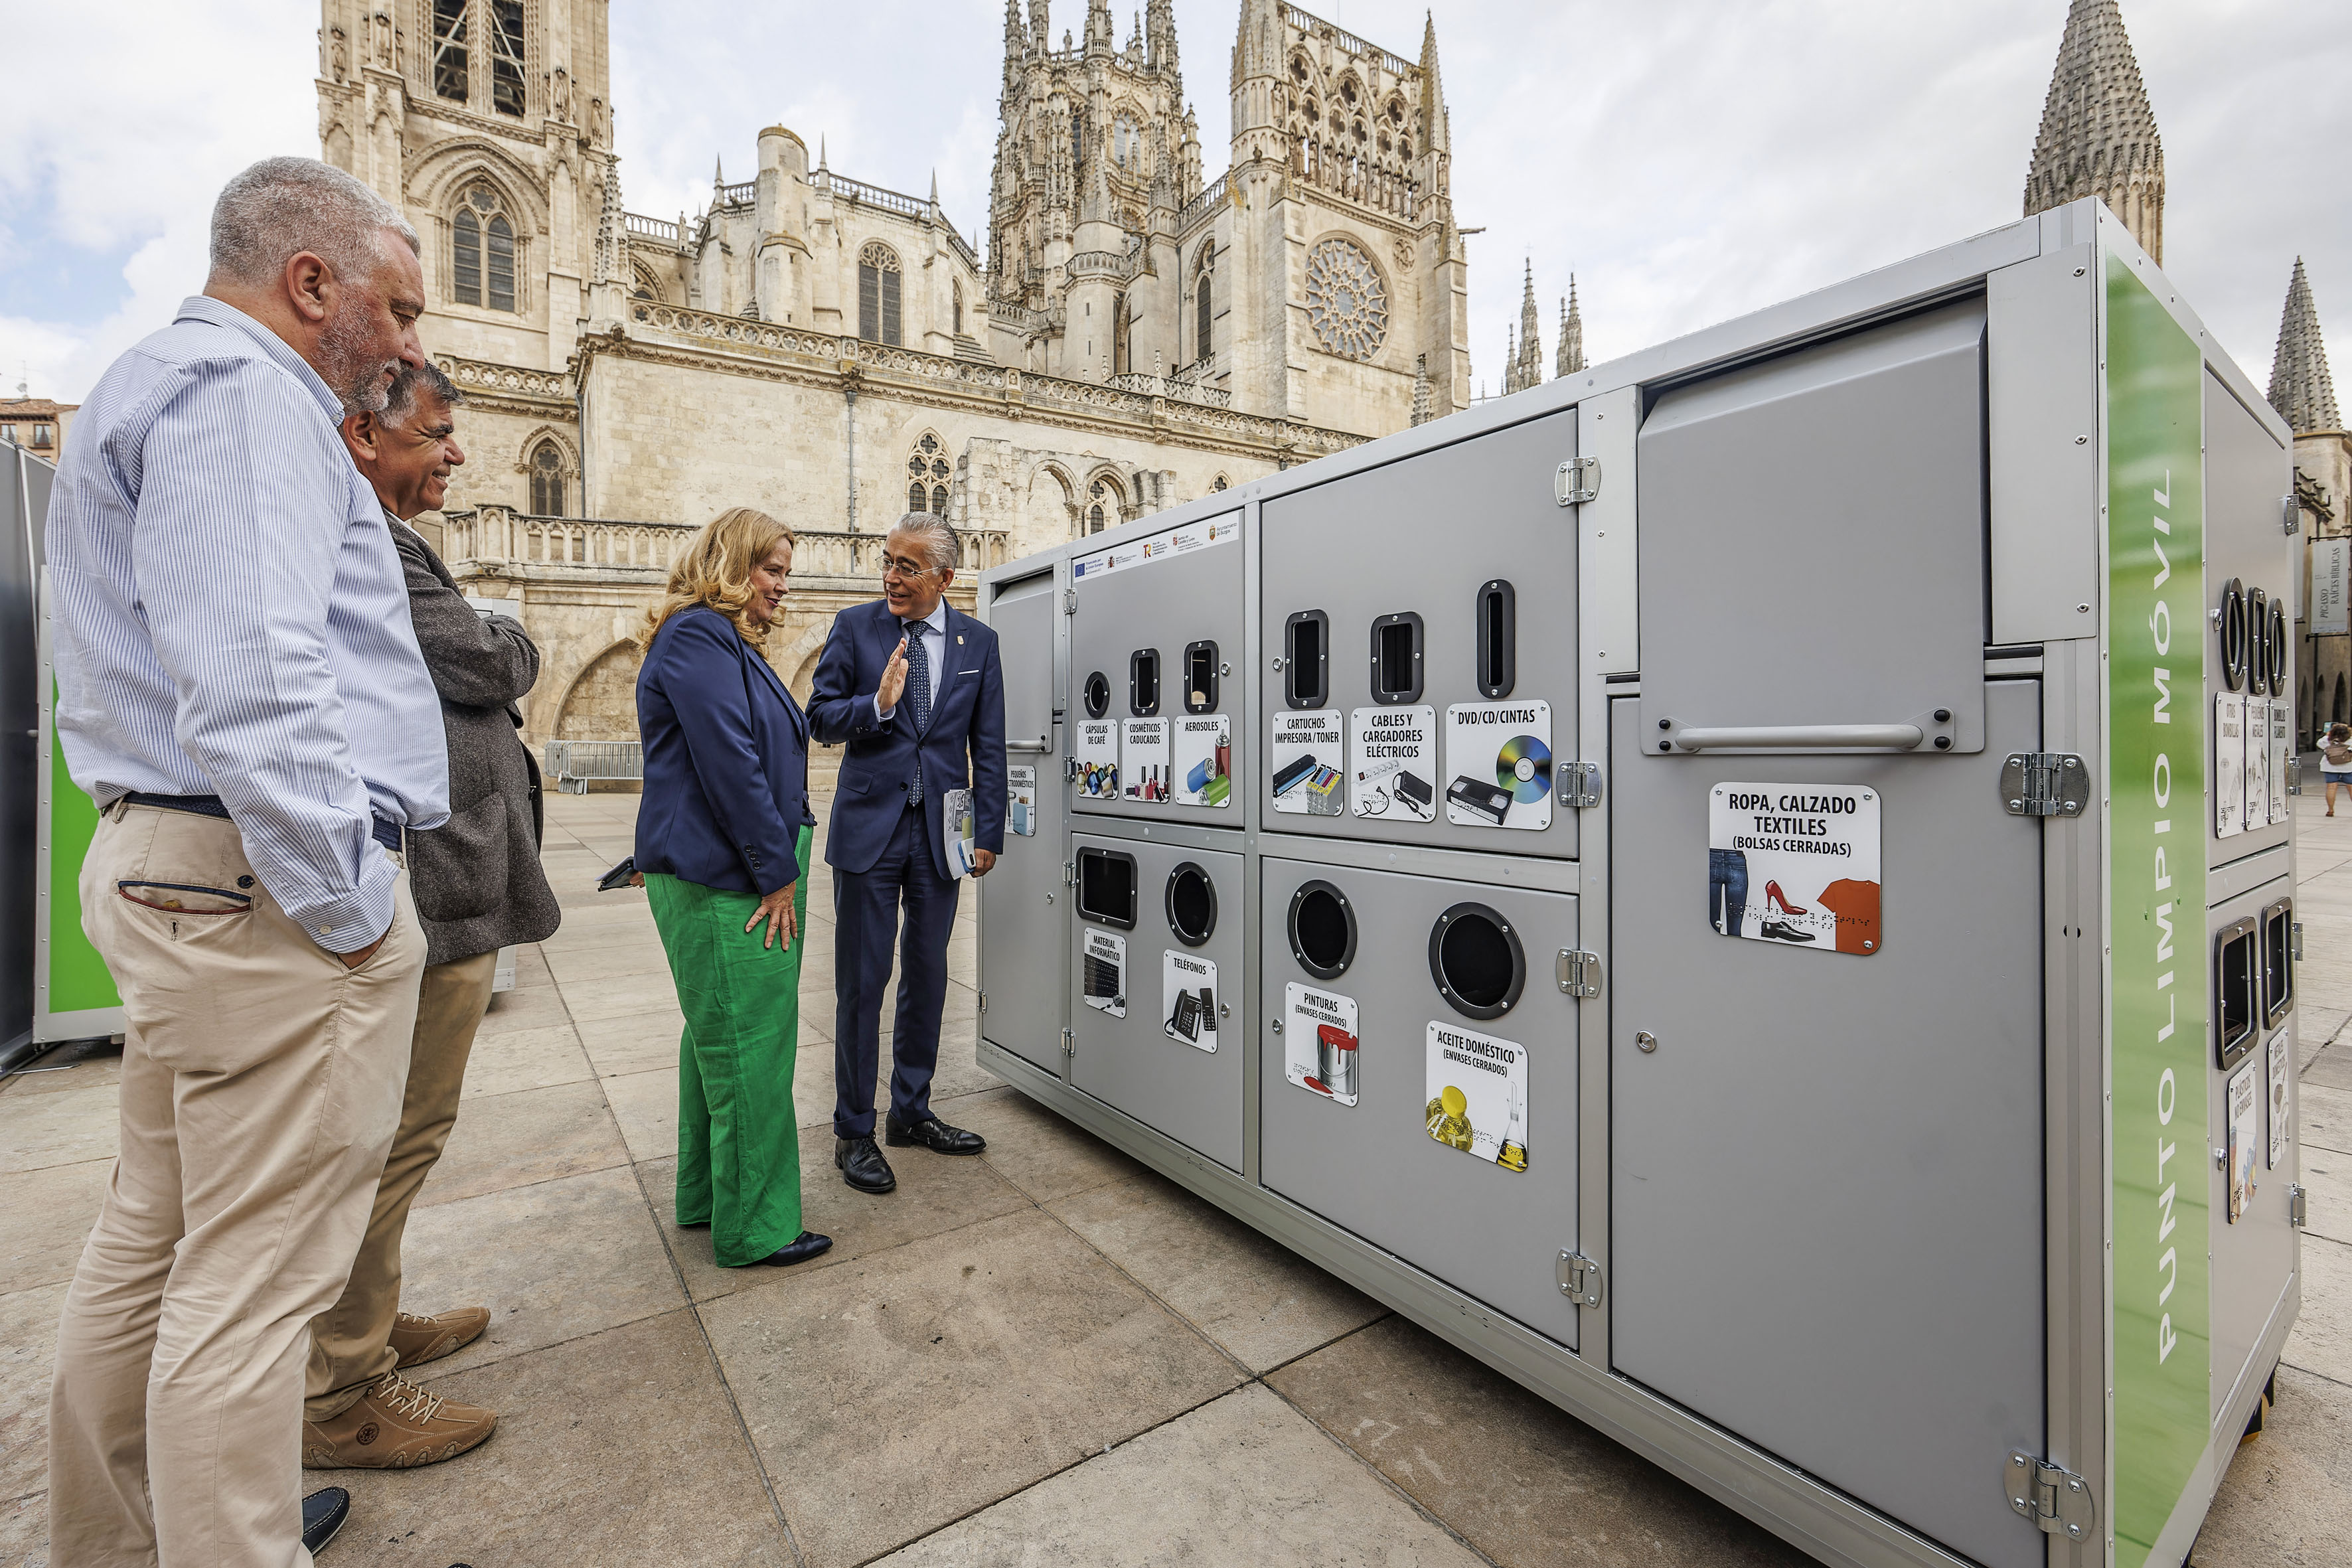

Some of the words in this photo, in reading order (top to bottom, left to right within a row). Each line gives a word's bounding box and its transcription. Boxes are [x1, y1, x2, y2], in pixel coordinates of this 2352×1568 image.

[2329, 547, 2341, 579] BÍBLICAS
[2149, 469, 2170, 723] MÓVIL
[2329, 580, 2339, 605] RAÍCES
[2320, 589, 2329, 619] PICASSO
[1185, 721, 1219, 732] AEROSOLES
[1287, 717, 1326, 730] CARTUCHOS
[1372, 714, 1403, 728] CABLES
[1403, 714, 1413, 726] Y
[1458, 709, 1535, 726] DVD/CD/CINTAS
[1085, 724, 1108, 734] CÁPSULAS
[1129, 722, 1161, 733] COSMÉTICOS
[1363, 730, 1423, 742] CARGADORES
[1094, 734, 1105, 744] CAFÉ
[1130, 735, 1160, 744] CADUCADOS
[1366, 743, 1419, 758] ELÉCTRICOS
[1011, 769, 1026, 779] PEQUEÑOS
[1729, 793, 1776, 813] ROPA,
[1779, 795, 1856, 815] CALZADO
[1754, 816, 1827, 836] TEXTILES
[1733, 835, 1780, 851] (BOLSAS
[1783, 839, 1851, 858] CERRADAS)
[2154, 753, 2174, 1043] LIMPIO
[1093, 935, 1116, 949] MATERIAL
[1089, 944, 1120, 961] INFORMÁTICO
[1173, 957, 1206, 975] TELÉFONOS
[1304, 992, 1338, 1013] PINTURAS
[1295, 1003, 1318, 1019] (ENVASES
[1318, 1010, 1347, 1029] CERRADOS)
[1437, 1030, 1464, 1050] ACEITE
[1465, 1036, 1515, 1064] DOMÉSTICO
[1443, 1048, 1472, 1066] (ENVASES
[1472, 1056, 1508, 1078] CERRADOS)
[2158, 1067, 2176, 1365] PUNTO
